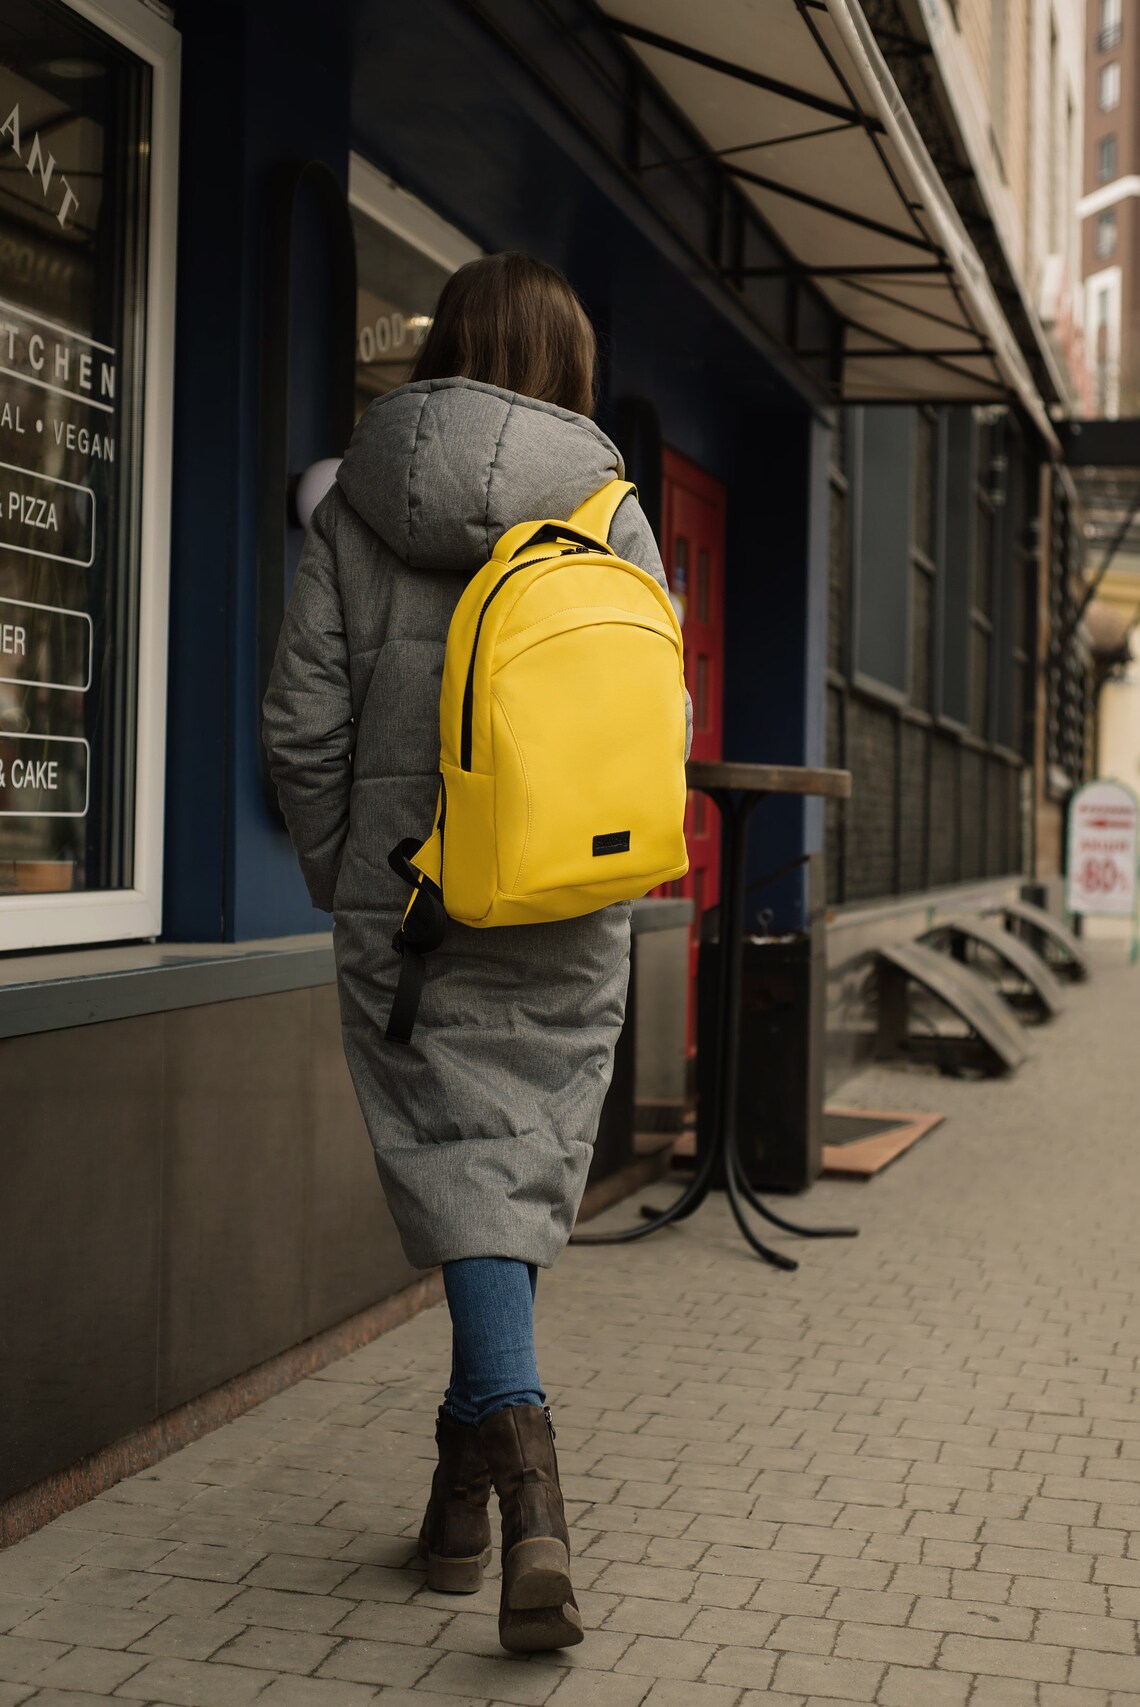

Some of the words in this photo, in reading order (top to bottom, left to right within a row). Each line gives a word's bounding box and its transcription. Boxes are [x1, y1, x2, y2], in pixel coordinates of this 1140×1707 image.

[0, 103, 80, 229] ANT
[4, 323, 115, 399] TCHEN
[53, 419, 115, 463] VEGAN
[8, 491, 58, 532] PIZZA
[0, 623, 26, 656] ER
[11, 758, 58, 790] CAKE
